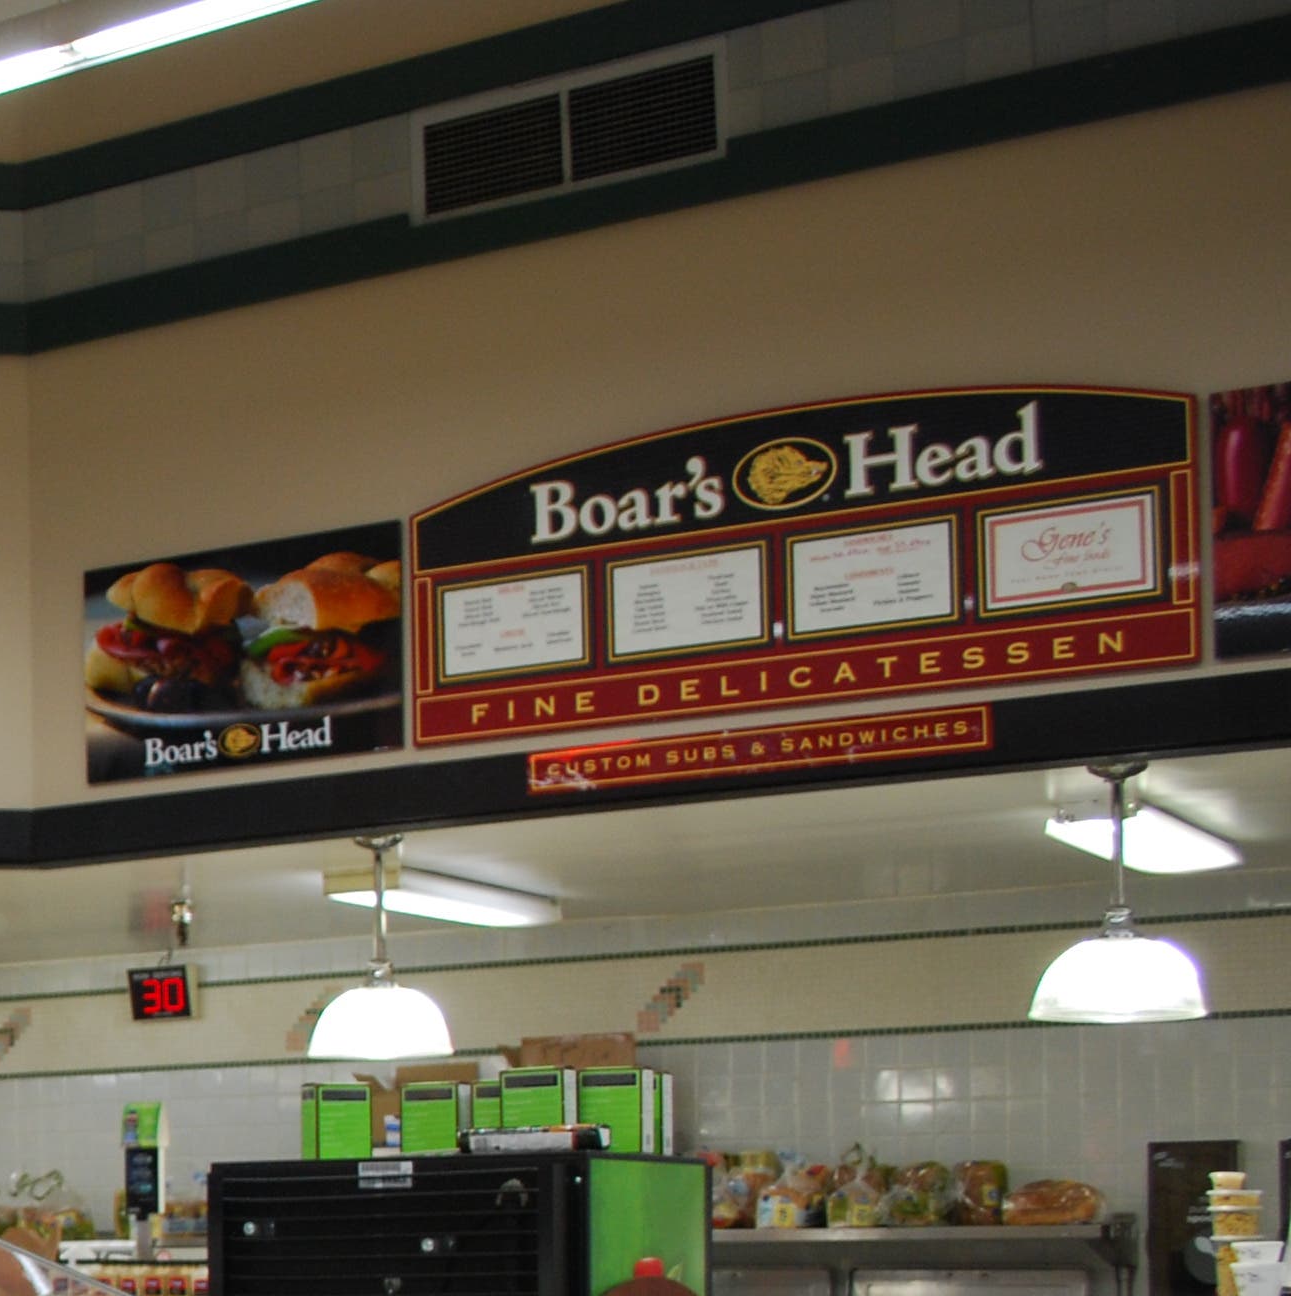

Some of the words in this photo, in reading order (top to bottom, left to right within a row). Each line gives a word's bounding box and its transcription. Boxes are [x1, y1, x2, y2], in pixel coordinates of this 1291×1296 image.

[530, 456, 724, 544] Boar's
[843, 401, 1043, 499] Head
[1021, 521, 1113, 562] Gene's
[471, 691, 595, 724] FINE
[636, 630, 1125, 706] DELICATESSEN
[145, 730, 217, 767] Boar's
[260, 715, 332, 752] Head
[546, 752, 652, 778] CUSTOM
[666, 745, 736, 765] SUBS
[751, 741, 766, 757] &
[780, 720, 969, 753] SANDWICHES
[141, 976, 186, 1014] 30
